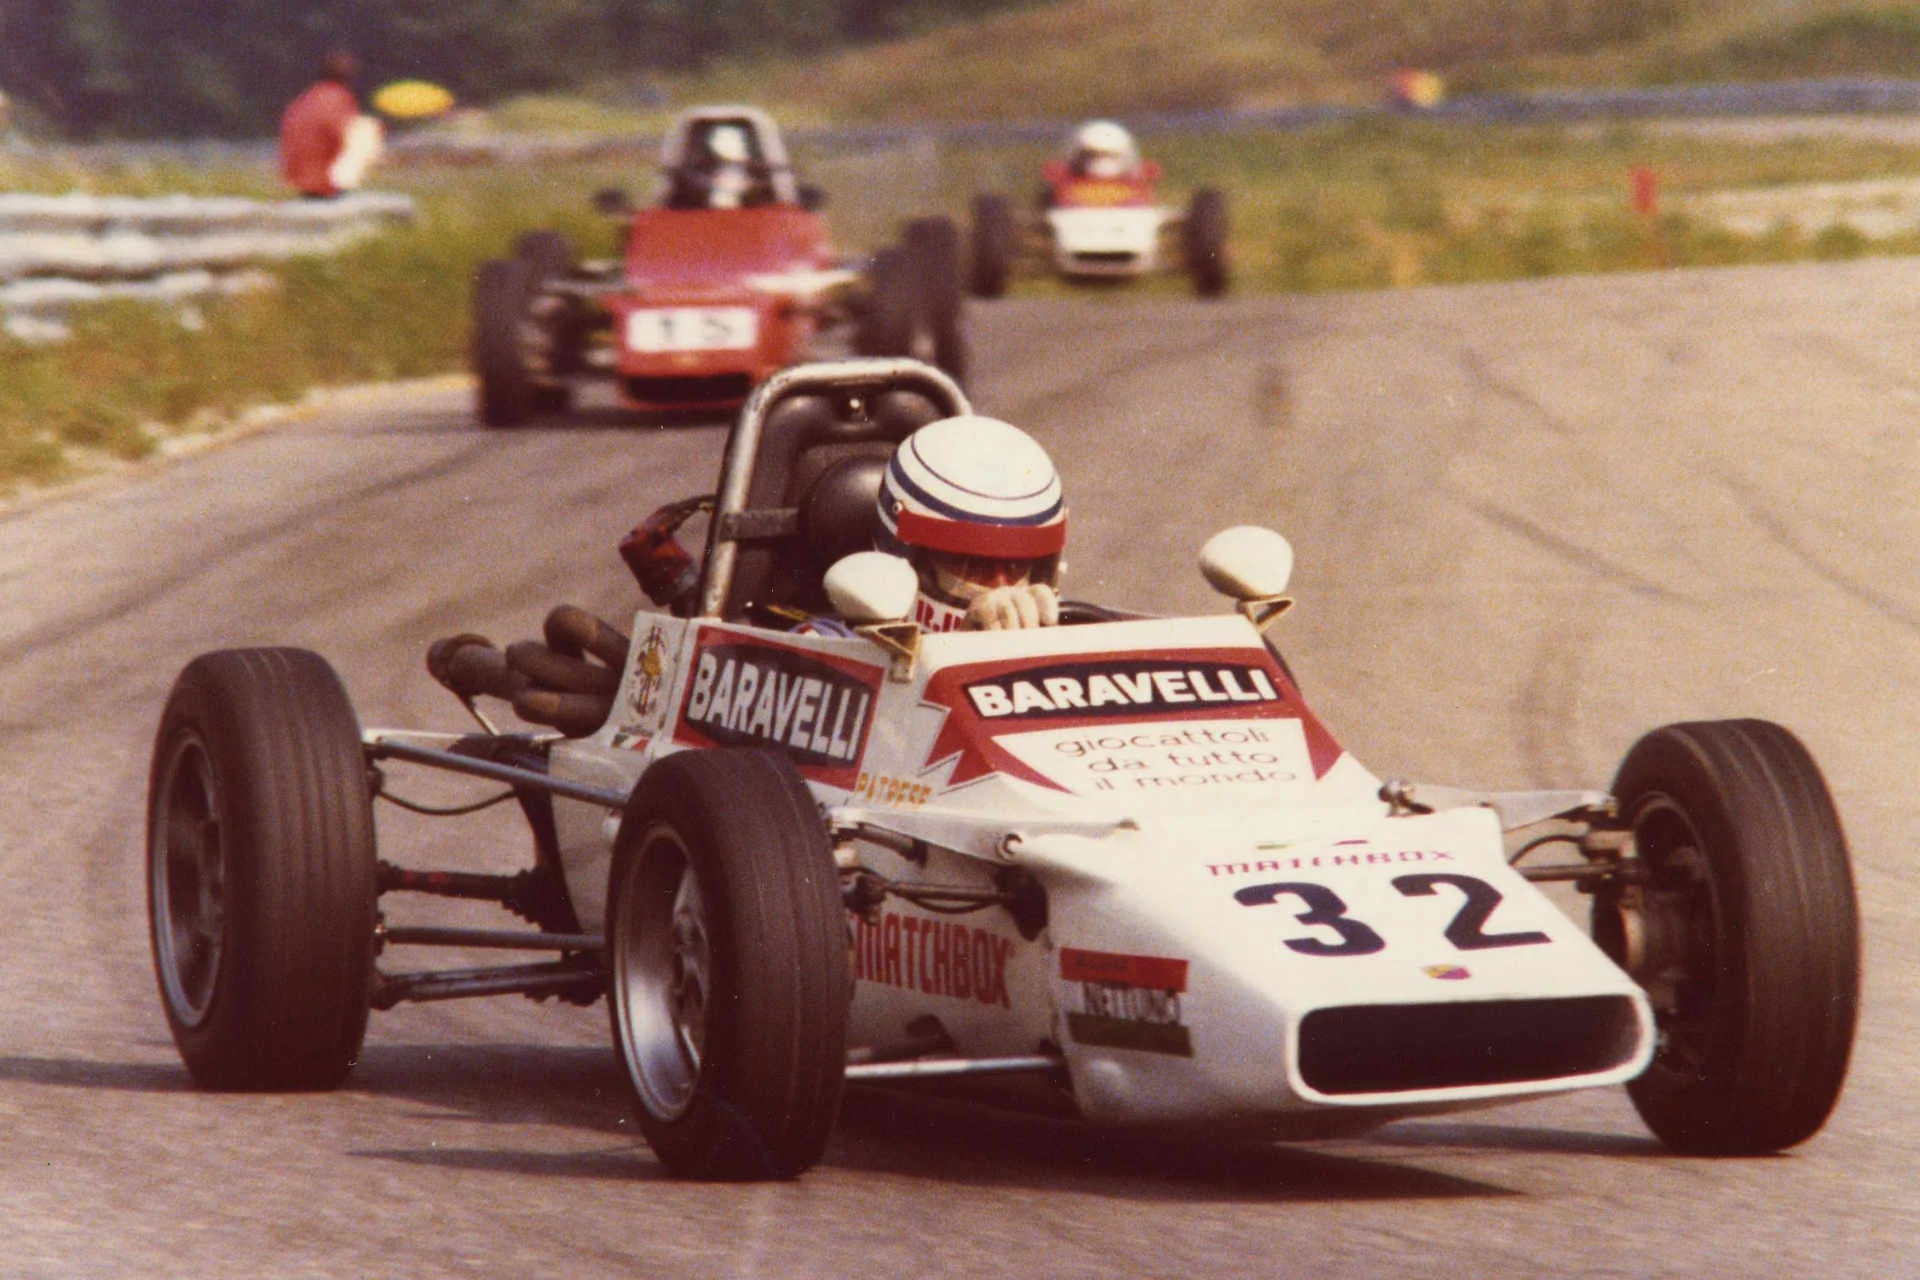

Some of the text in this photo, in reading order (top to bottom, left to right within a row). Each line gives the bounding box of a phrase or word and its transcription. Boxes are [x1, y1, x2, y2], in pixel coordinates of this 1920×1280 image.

[687, 652, 870, 761] BARAVELLI
[967, 669, 1279, 718] BARAVELLI
[1054, 727, 1270, 758] giocattoli
[1088, 750, 1279, 773] da tutto
[1095, 769, 1297, 791] il mondo
[1233, 873, 1552, 957] 32
[855, 911, 1017, 1010] MATCHBOX
